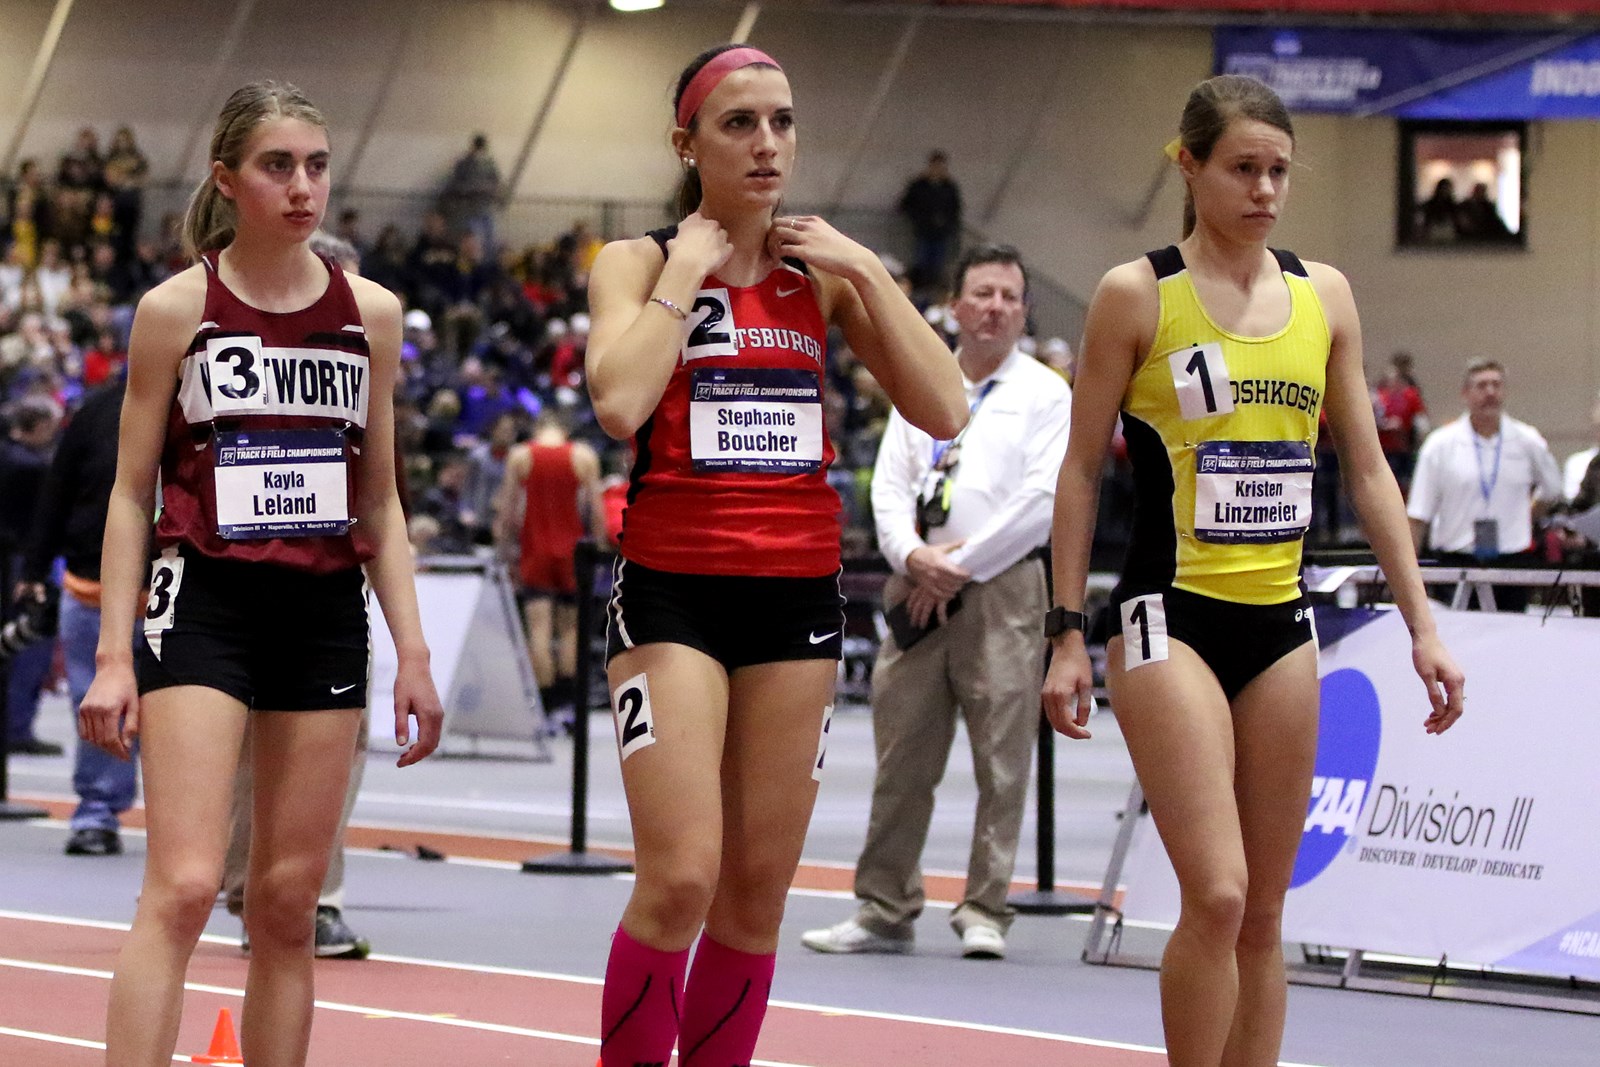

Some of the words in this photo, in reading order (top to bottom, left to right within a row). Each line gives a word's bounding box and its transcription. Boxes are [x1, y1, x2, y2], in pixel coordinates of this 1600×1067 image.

[687, 296, 731, 348] 2
[736, 328, 821, 366] TSBURGH
[215, 346, 260, 399] 3
[1185, 350, 1217, 414] 1
[712, 387, 735, 396] TRACK
[740, 387, 759, 396] FIELD
[760, 388, 818, 397] CHAMPIONSHIPS
[718, 408, 796, 427] Stephanie
[236, 450, 260, 460] TRACK
[267, 449, 286, 458] FIELD
[287, 447, 342, 458] CHAMPIONSHIPS
[717, 431, 798, 452] Boucher
[1218, 459, 1239, 468] TRACK
[1247, 459, 1265, 468] FIELD
[263, 470, 305, 491] Kayla
[1235, 480, 1283, 497] Kristen
[253, 493, 316, 516] Leland
[1214, 501, 1298, 524] Linzmeier
[146, 567, 174, 619] 3
[1130, 600, 1151, 661] 1
[618, 687, 648, 748] 2
[1303, 776, 1367, 836] AA
[1368, 784, 1495, 848] Division
[1502, 797, 1534, 850] III
[1359, 847, 1417, 867] DISCOVER
[1422, 856, 1478, 873] DEVELOP
[1482, 860, 1544, 880] DEDICATE
